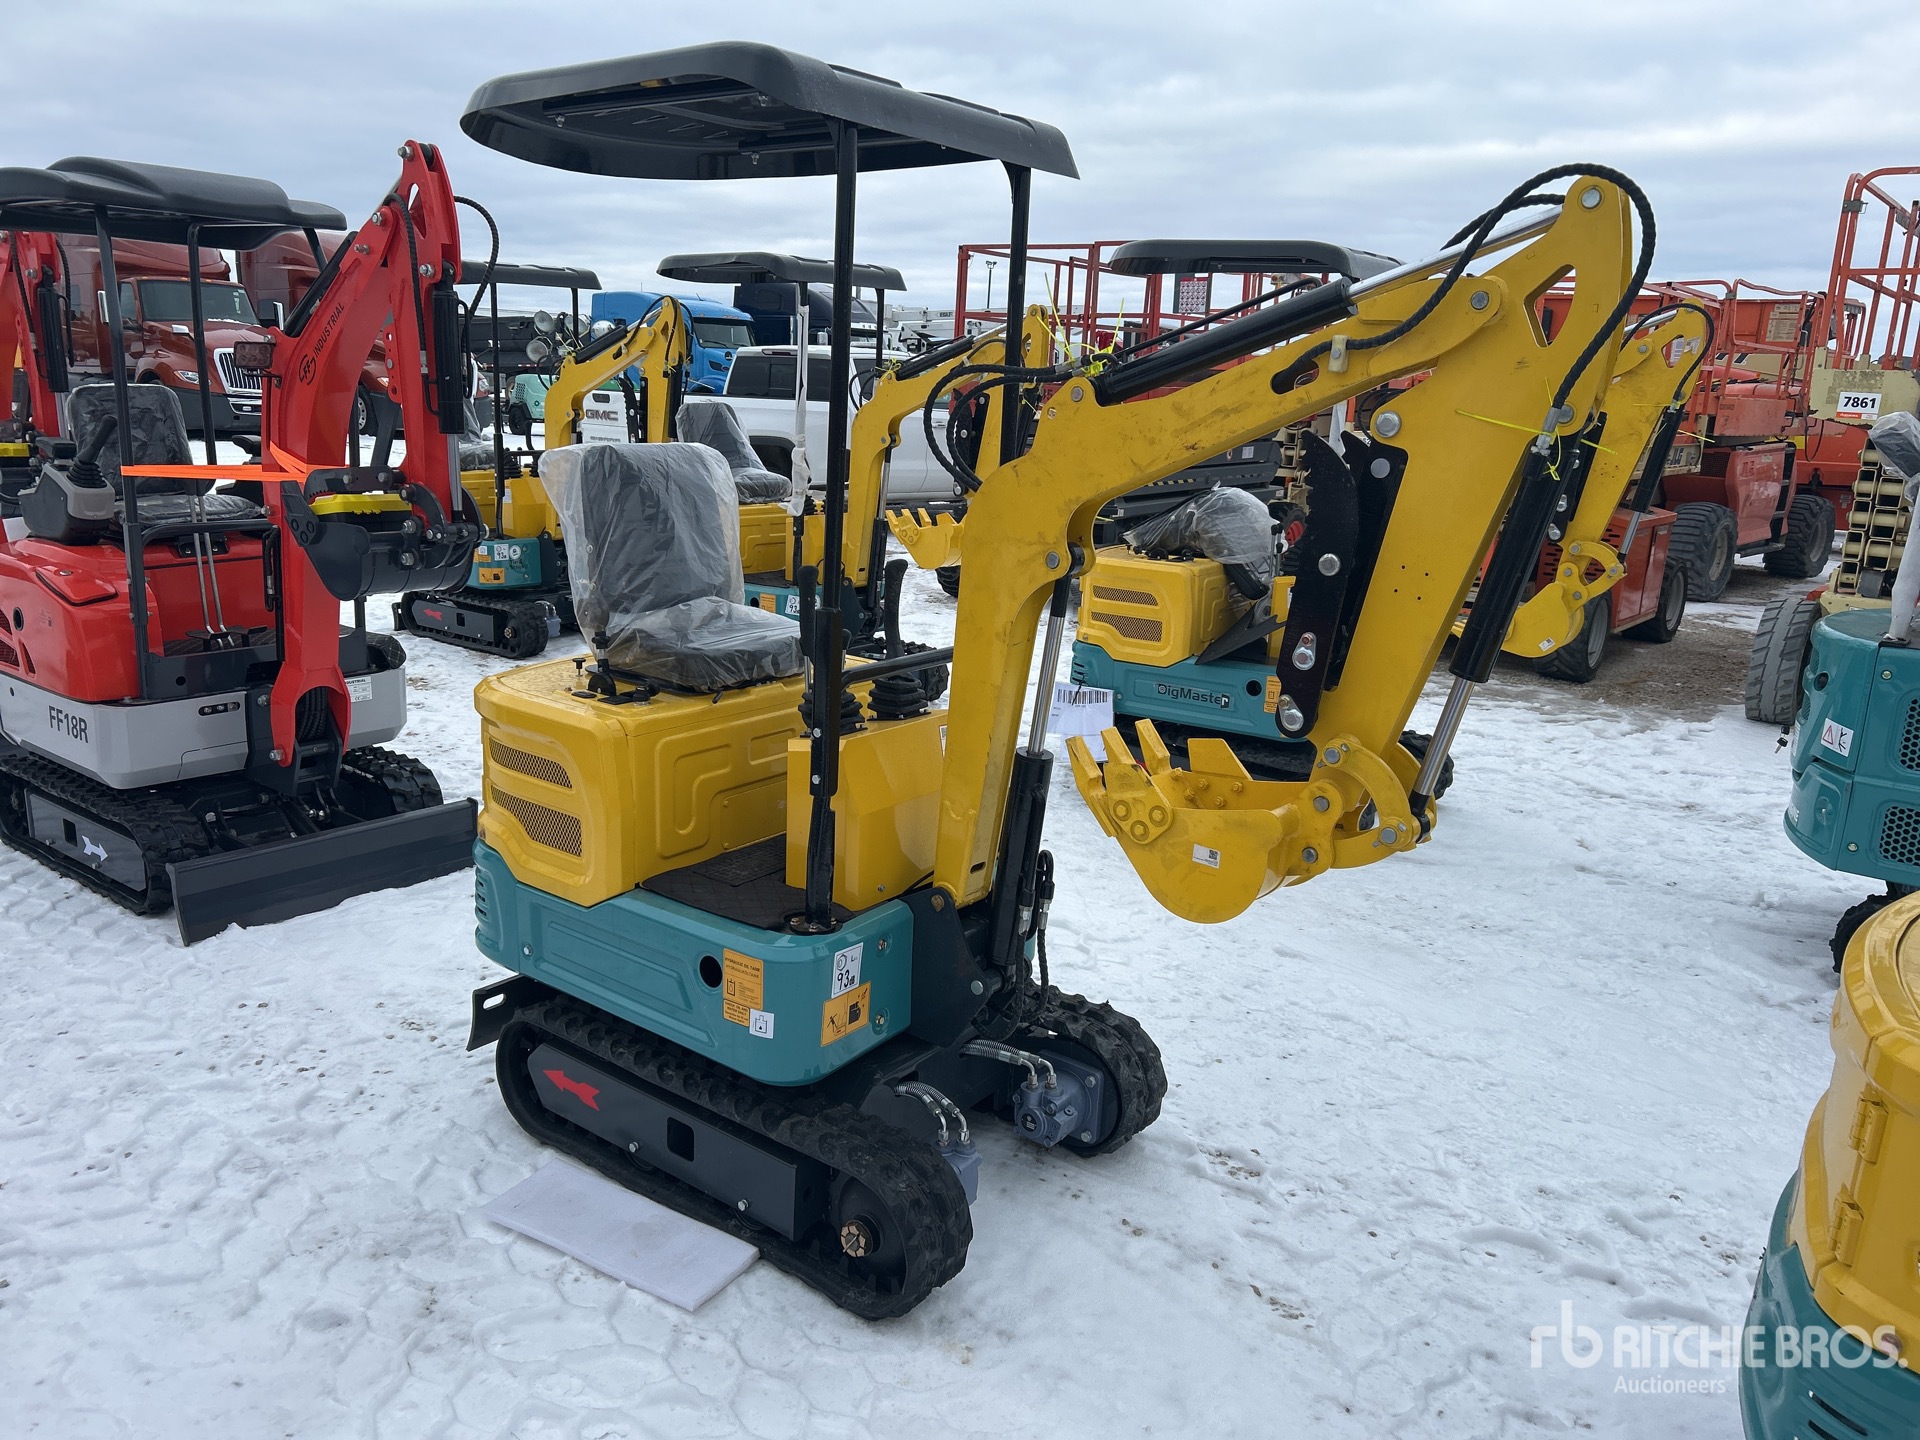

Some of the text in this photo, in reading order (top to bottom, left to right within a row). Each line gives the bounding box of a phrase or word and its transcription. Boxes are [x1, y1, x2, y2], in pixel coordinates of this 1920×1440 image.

[313, 303, 344, 358] INDUSTRIAL
[586, 409, 618, 421] GMC
[1843, 396, 1876, 409] 7861
[1158, 683, 1231, 709] DigMaster
[49, 705, 88, 744] FF18R
